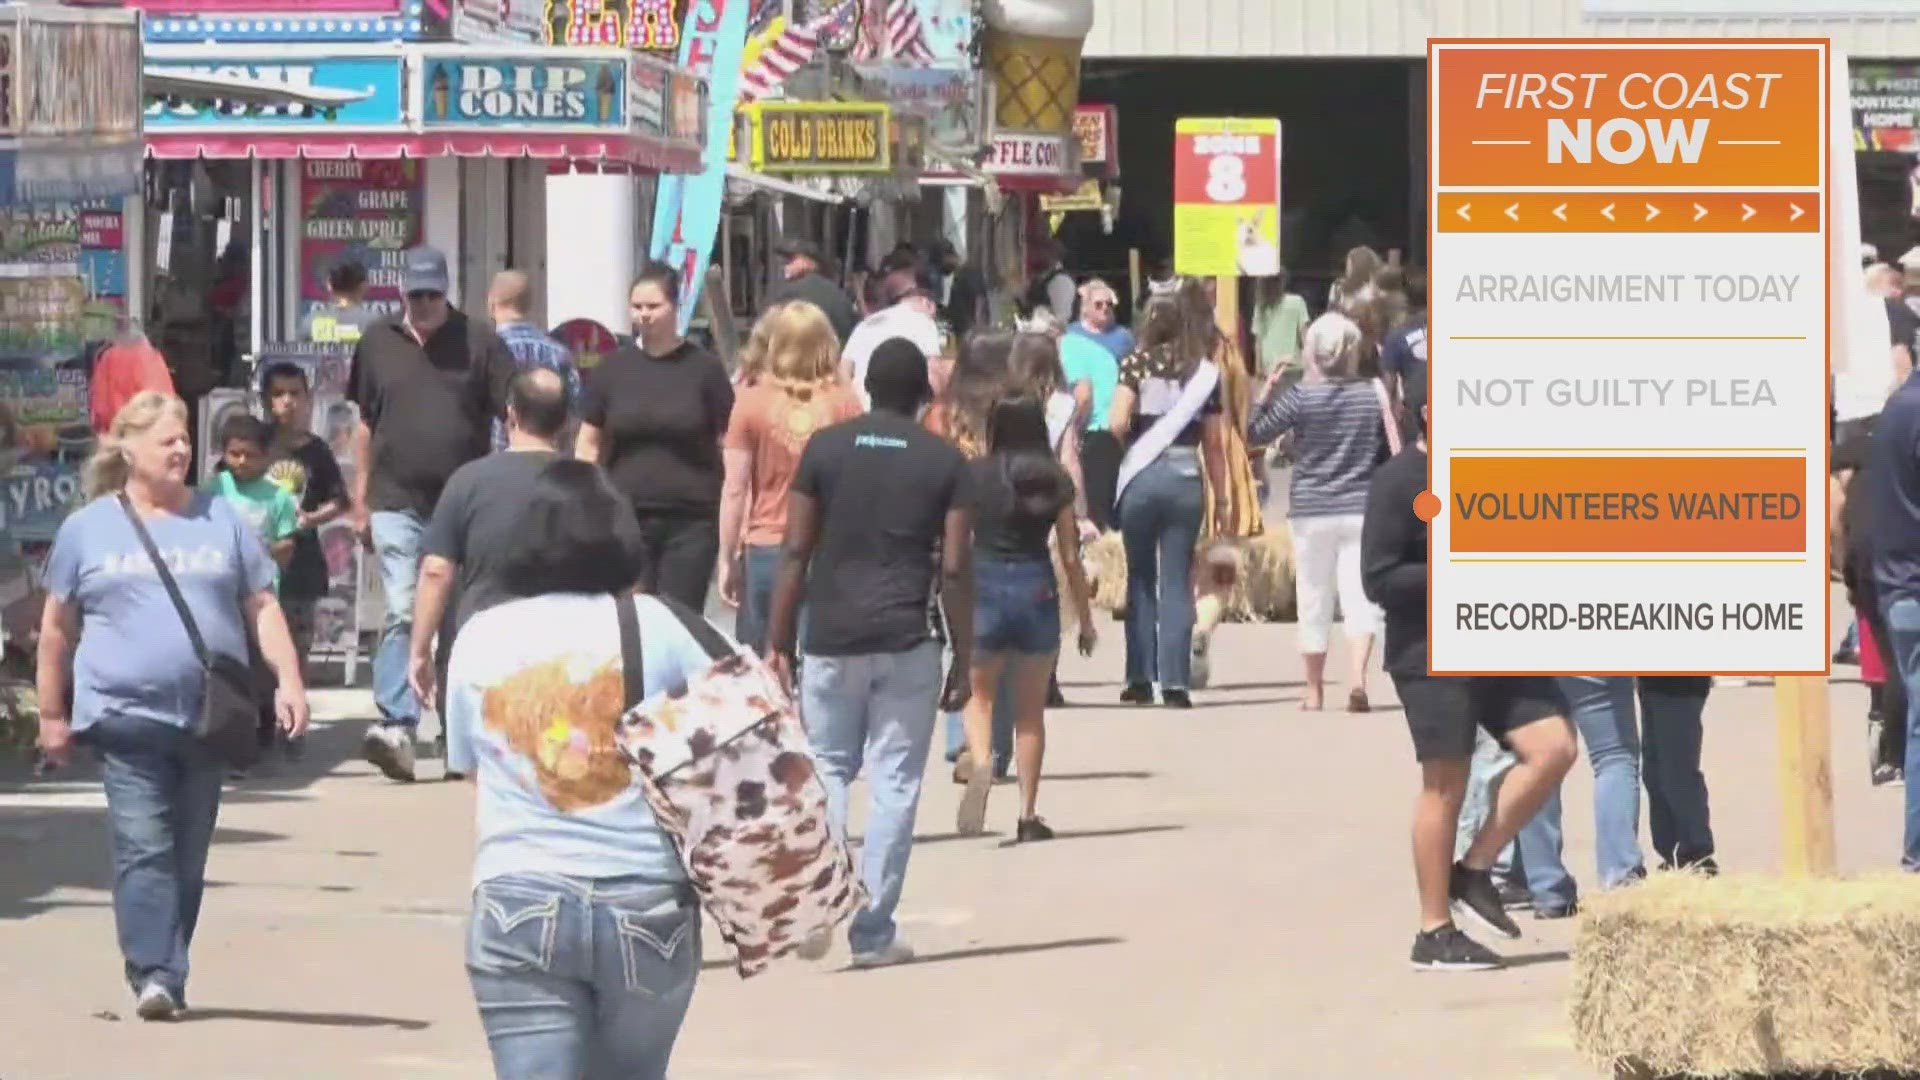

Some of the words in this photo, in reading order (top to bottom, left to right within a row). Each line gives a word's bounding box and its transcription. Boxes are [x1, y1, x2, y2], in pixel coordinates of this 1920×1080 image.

[461, 66, 587, 91] DIP
[459, 91, 586, 117] CONES
[770, 119, 811, 159] COLD
[816, 119, 876, 159] DRINKS
[306, 158, 363, 179] CHERRY
[1206, 156, 1246, 202] 8
[358, 191, 408, 209] GRAPE
[306, 220, 354, 239] GREEN
[359, 220, 408, 239] APPLE
